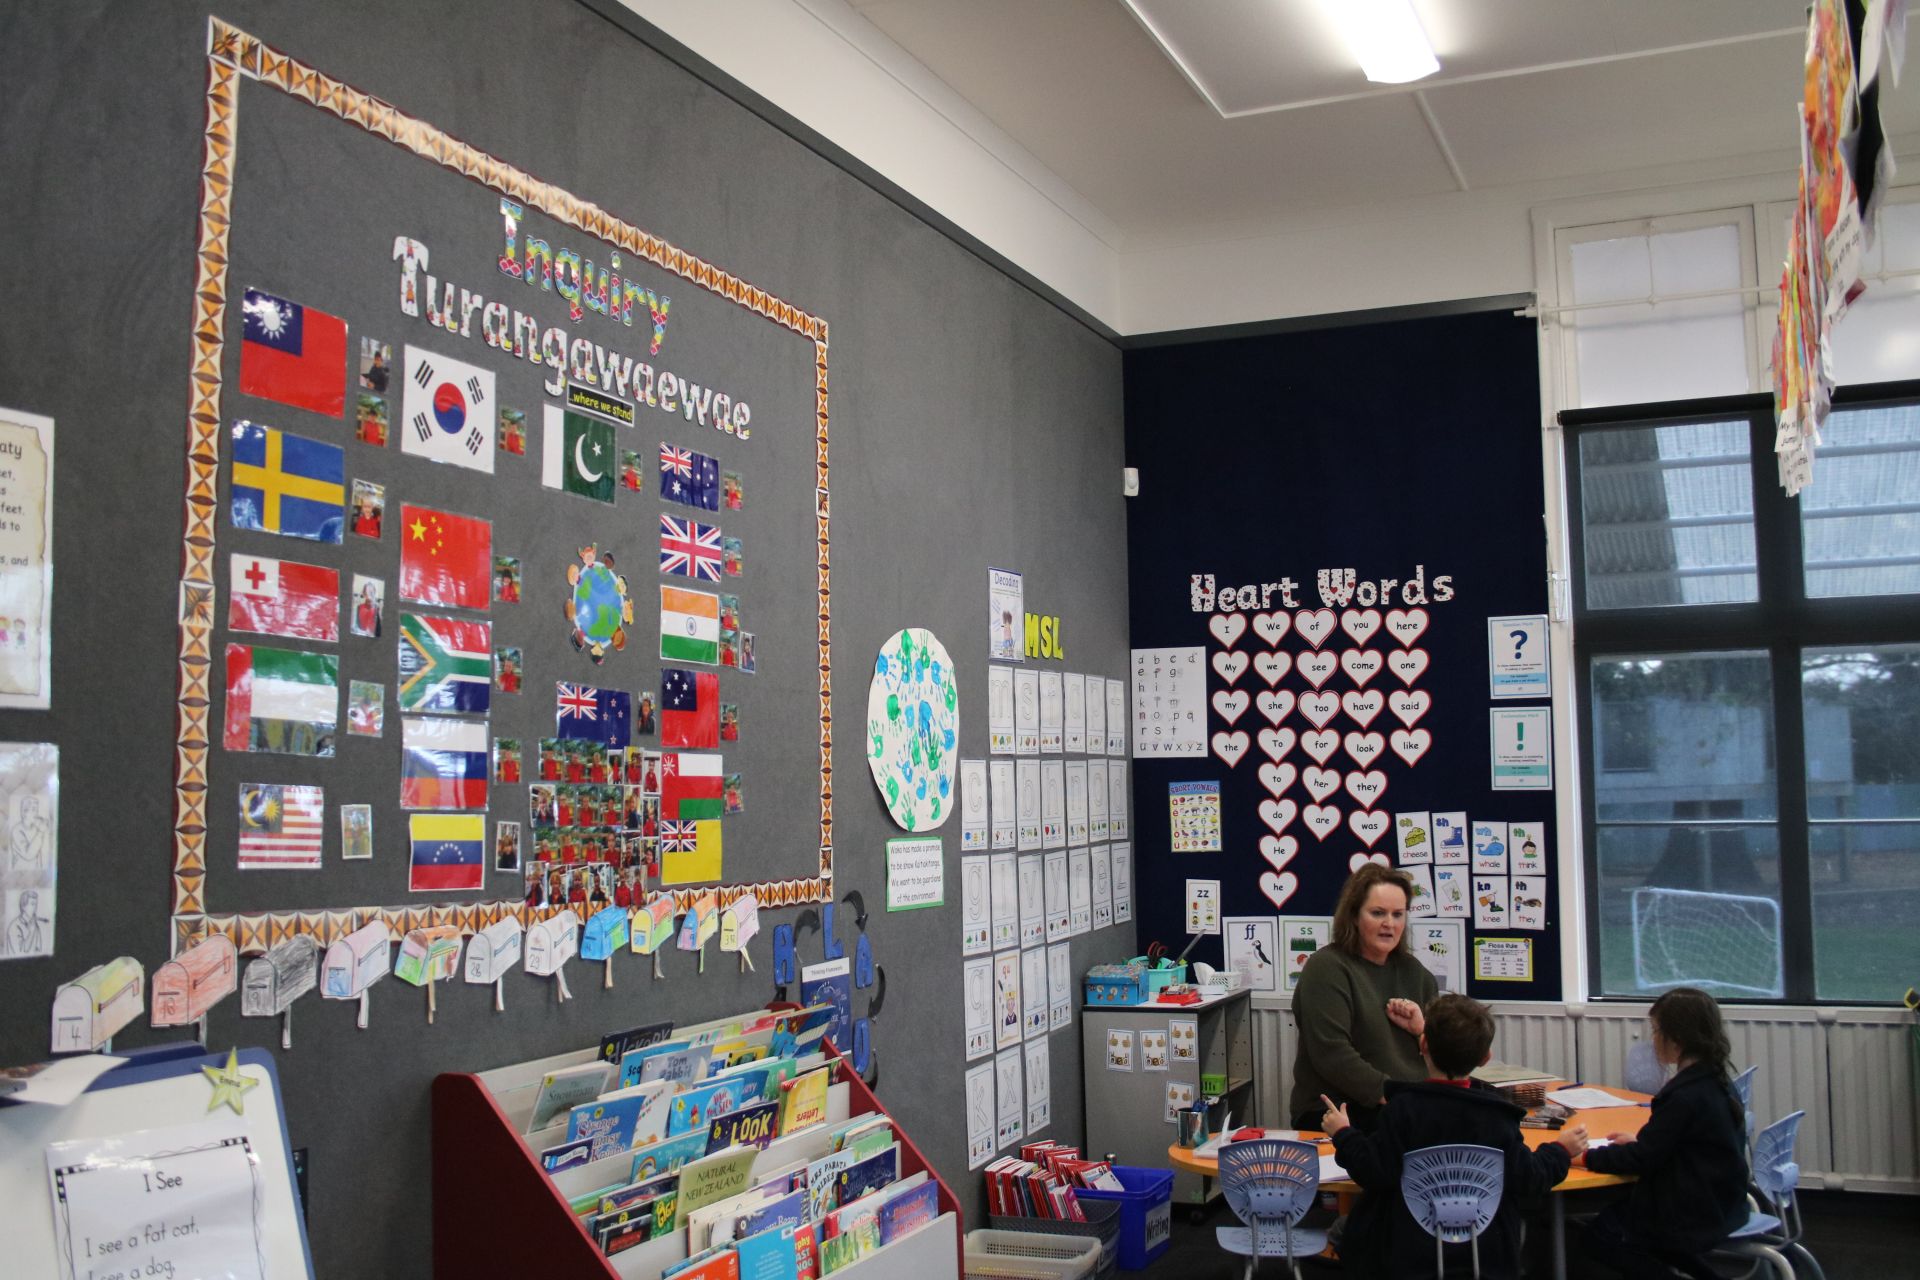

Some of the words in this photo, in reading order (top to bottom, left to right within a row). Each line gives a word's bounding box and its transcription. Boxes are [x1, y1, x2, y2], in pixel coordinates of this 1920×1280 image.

[498, 197, 671, 358] Inquiry
[392, 235, 752, 440] Turangawaewae
[600, 402, 612, 413] we
[10, 521, 21, 532] to
[10, 555, 29, 567] and
[1190, 573, 1301, 613] Heart
[1317, 564, 1455, 609] Words
[1224, 625, 1230, 634] I
[1266, 621, 1281, 630] We
[1310, 621, 1319, 630] of
[1353, 621, 1368, 630] you
[1397, 621, 1418, 630] here
[1024, 612, 1064, 660] MSL
[1138, 655, 1144, 664] a
[1154, 656, 1160, 665] b
[1170, 655, 1176, 663] c
[1224, 663, 1237, 672] My
[1351, 662, 1374, 670] come
[1138, 668, 1144, 676] e
[1169, 668, 1176, 678] g
[1138, 682, 1145, 692] h
[1139, 700, 1145, 708] k
[1225, 702, 1237, 710] my
[1268, 701, 1283, 709] she
[1314, 704, 1329, 712] too
[1353, 702, 1374, 710] have
[1139, 711, 1146, 720] n
[1153, 711, 1160, 719] o
[1173, 712, 1179, 721] p
[1187, 711, 1194, 722] q
[1142, 727, 1147, 735] r
[1154, 726, 1161, 735] s
[1169, 726, 1176, 735] t
[1140, 743, 1146, 751] u
[1152, 743, 1159, 751] v
[1163, 743, 1173, 751] w
[1176, 743, 1182, 751] x
[1187, 743, 1193, 751] y
[1196, 742, 1203, 751] z
[1224, 743, 1238, 751] the
[1272, 739, 1283, 747] To
[1315, 740, 1328, 749] for
[1403, 741, 1419, 749] like
[1356, 744, 1374, 752] look
[1272, 774, 1281, 782] to
[1313, 779, 1328, 788] her
[1357, 782, 1378, 792] they
[1436, 817, 1449, 827] sh
[1273, 846, 1286, 854] He
[1402, 850, 1428, 859] cheese
[1442, 850, 1461, 858] shoe
[1479, 860, 1501, 868] whale
[1518, 861, 1537, 869] think
[1477, 881, 1491, 891] kn
[1515, 881, 1527, 891] th
[1197, 889, 1209, 898] zz
[1443, 904, 1463, 912] write
[1482, 914, 1501, 923] knee
[1243, 924, 1256, 940] ff
[1300, 927, 1313, 935] ss
[1428, 929, 1443, 938] zz
[667, 1056, 688, 1068] Tom
[730, 1112, 774, 1147] LOOK
[697, 1161, 738, 1181] NATURAL
[143, 1173, 152, 1193] I
[155, 1171, 184, 1191] See
[685, 1188, 703, 1202] NEW
[703, 1172, 745, 1197] ZEALAND
[1146, 1214, 1170, 1242] Writing
[84, 1237, 93, 1258] I
[98, 1238, 123, 1256] see
[128, 1235, 139, 1249] a
[143, 1222, 167, 1244] fat
[130, 1266, 141, 1279] a
